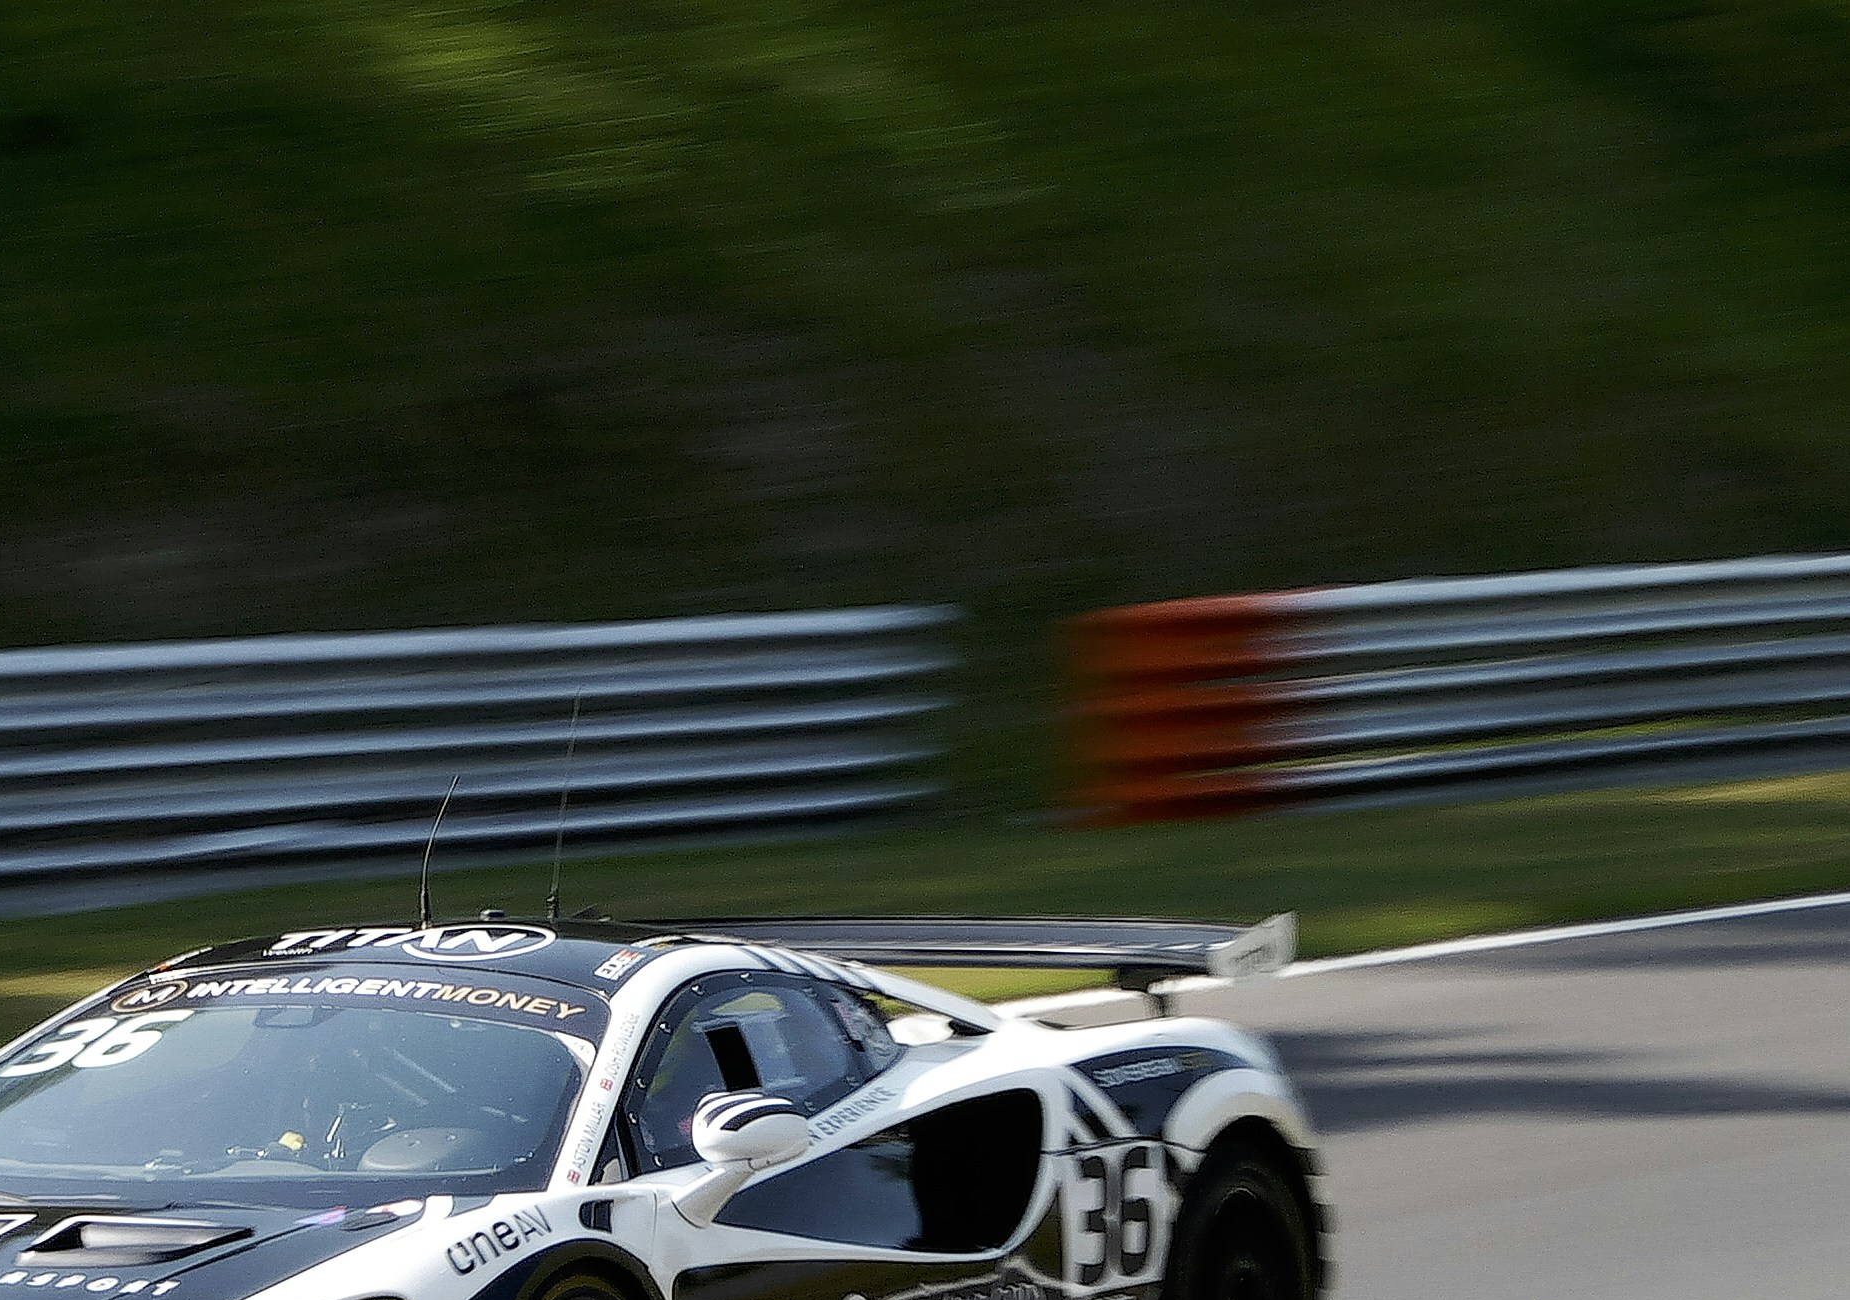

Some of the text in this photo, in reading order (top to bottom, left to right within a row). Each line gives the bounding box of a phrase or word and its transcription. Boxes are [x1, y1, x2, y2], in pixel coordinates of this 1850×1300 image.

[271, 926, 528, 953] TITAN
[0, 1009, 195, 1078] 36
[815, 1086, 898, 1136] EXPERIENCE
[571, 1138, 593, 1171] ASTON
